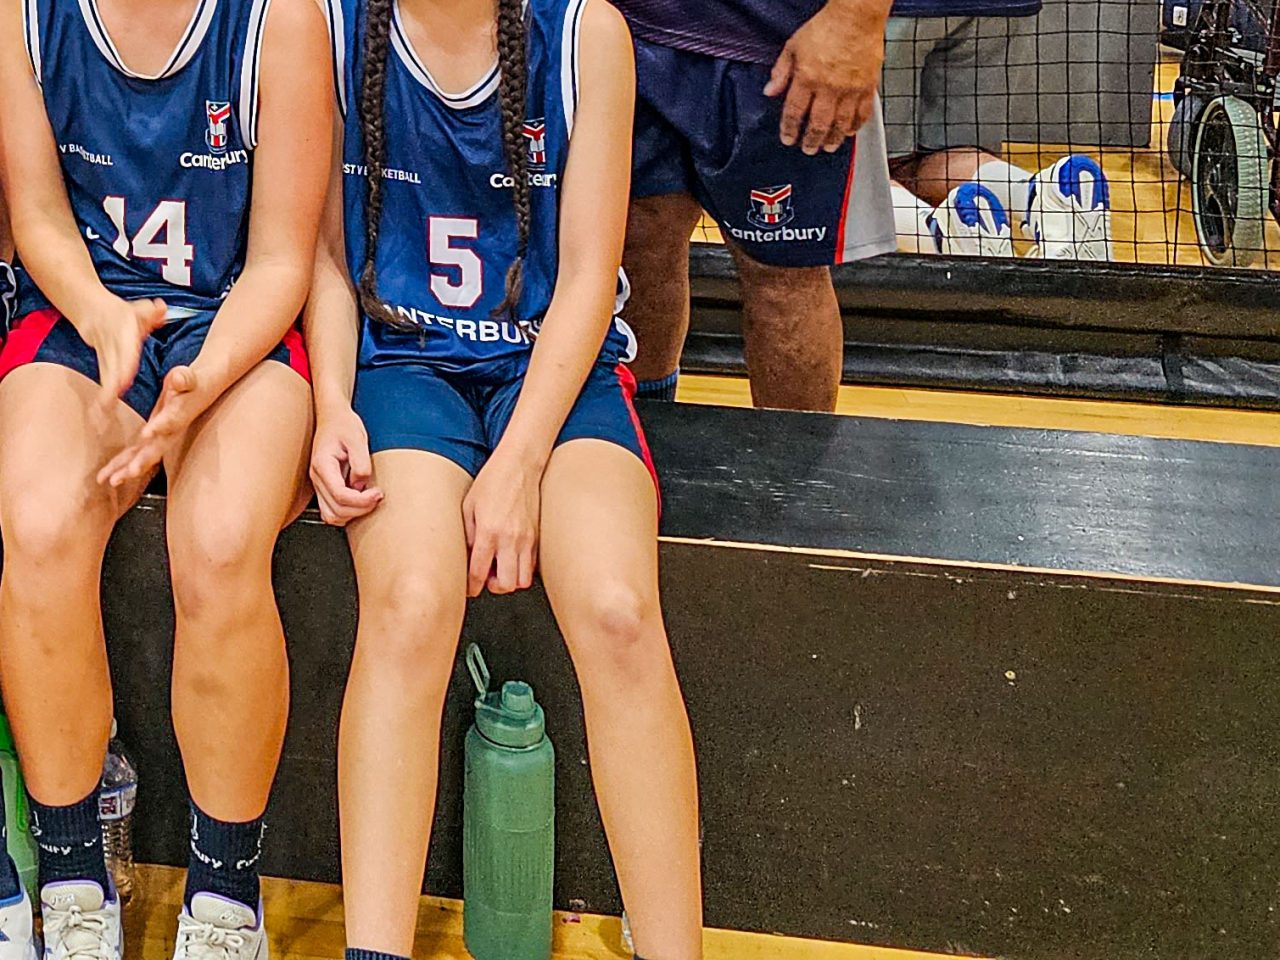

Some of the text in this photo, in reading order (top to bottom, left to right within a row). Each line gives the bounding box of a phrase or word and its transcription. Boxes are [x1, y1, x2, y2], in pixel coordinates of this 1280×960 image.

[59, 143, 67, 154] V
[102, 195, 194, 287] 14
[428, 215, 484, 308] 5
